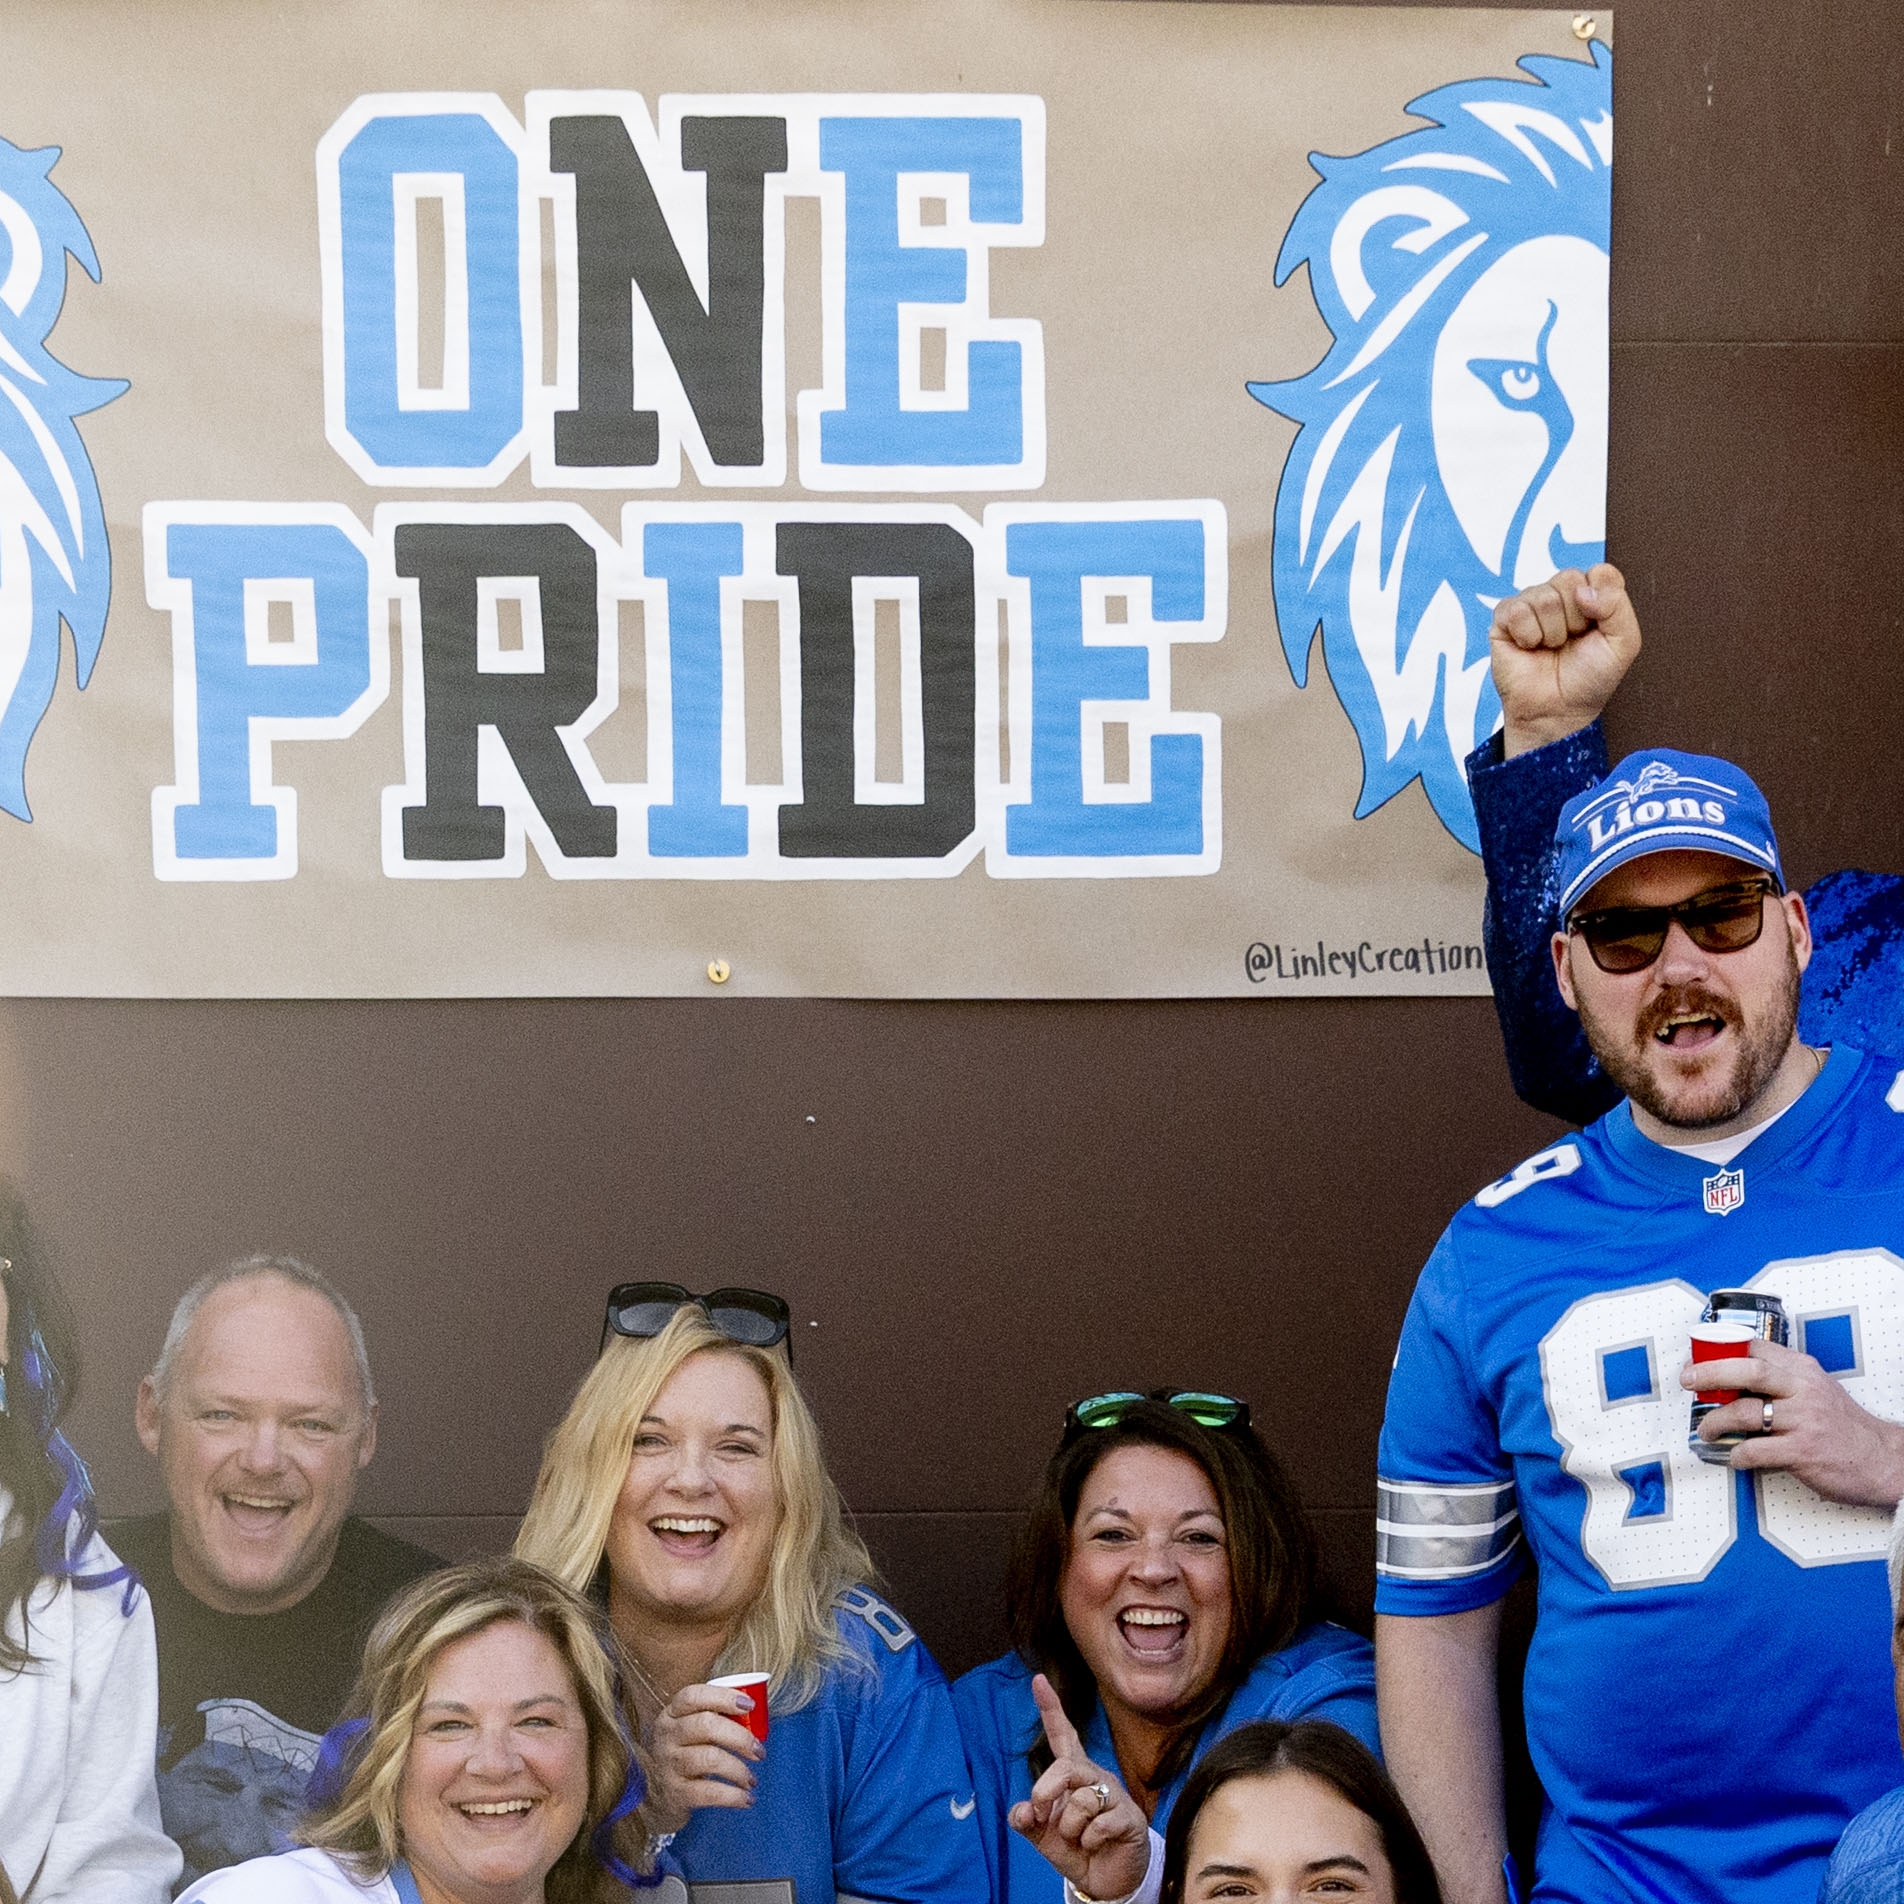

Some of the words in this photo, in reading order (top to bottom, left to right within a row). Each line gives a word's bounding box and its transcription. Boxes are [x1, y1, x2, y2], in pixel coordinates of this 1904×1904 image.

[317, 90, 1044, 489] ONE
[145, 500, 1226, 881] PRIDE
[1588, 797, 1725, 851] Lions
[1710, 1187, 1737, 1206] NFL
